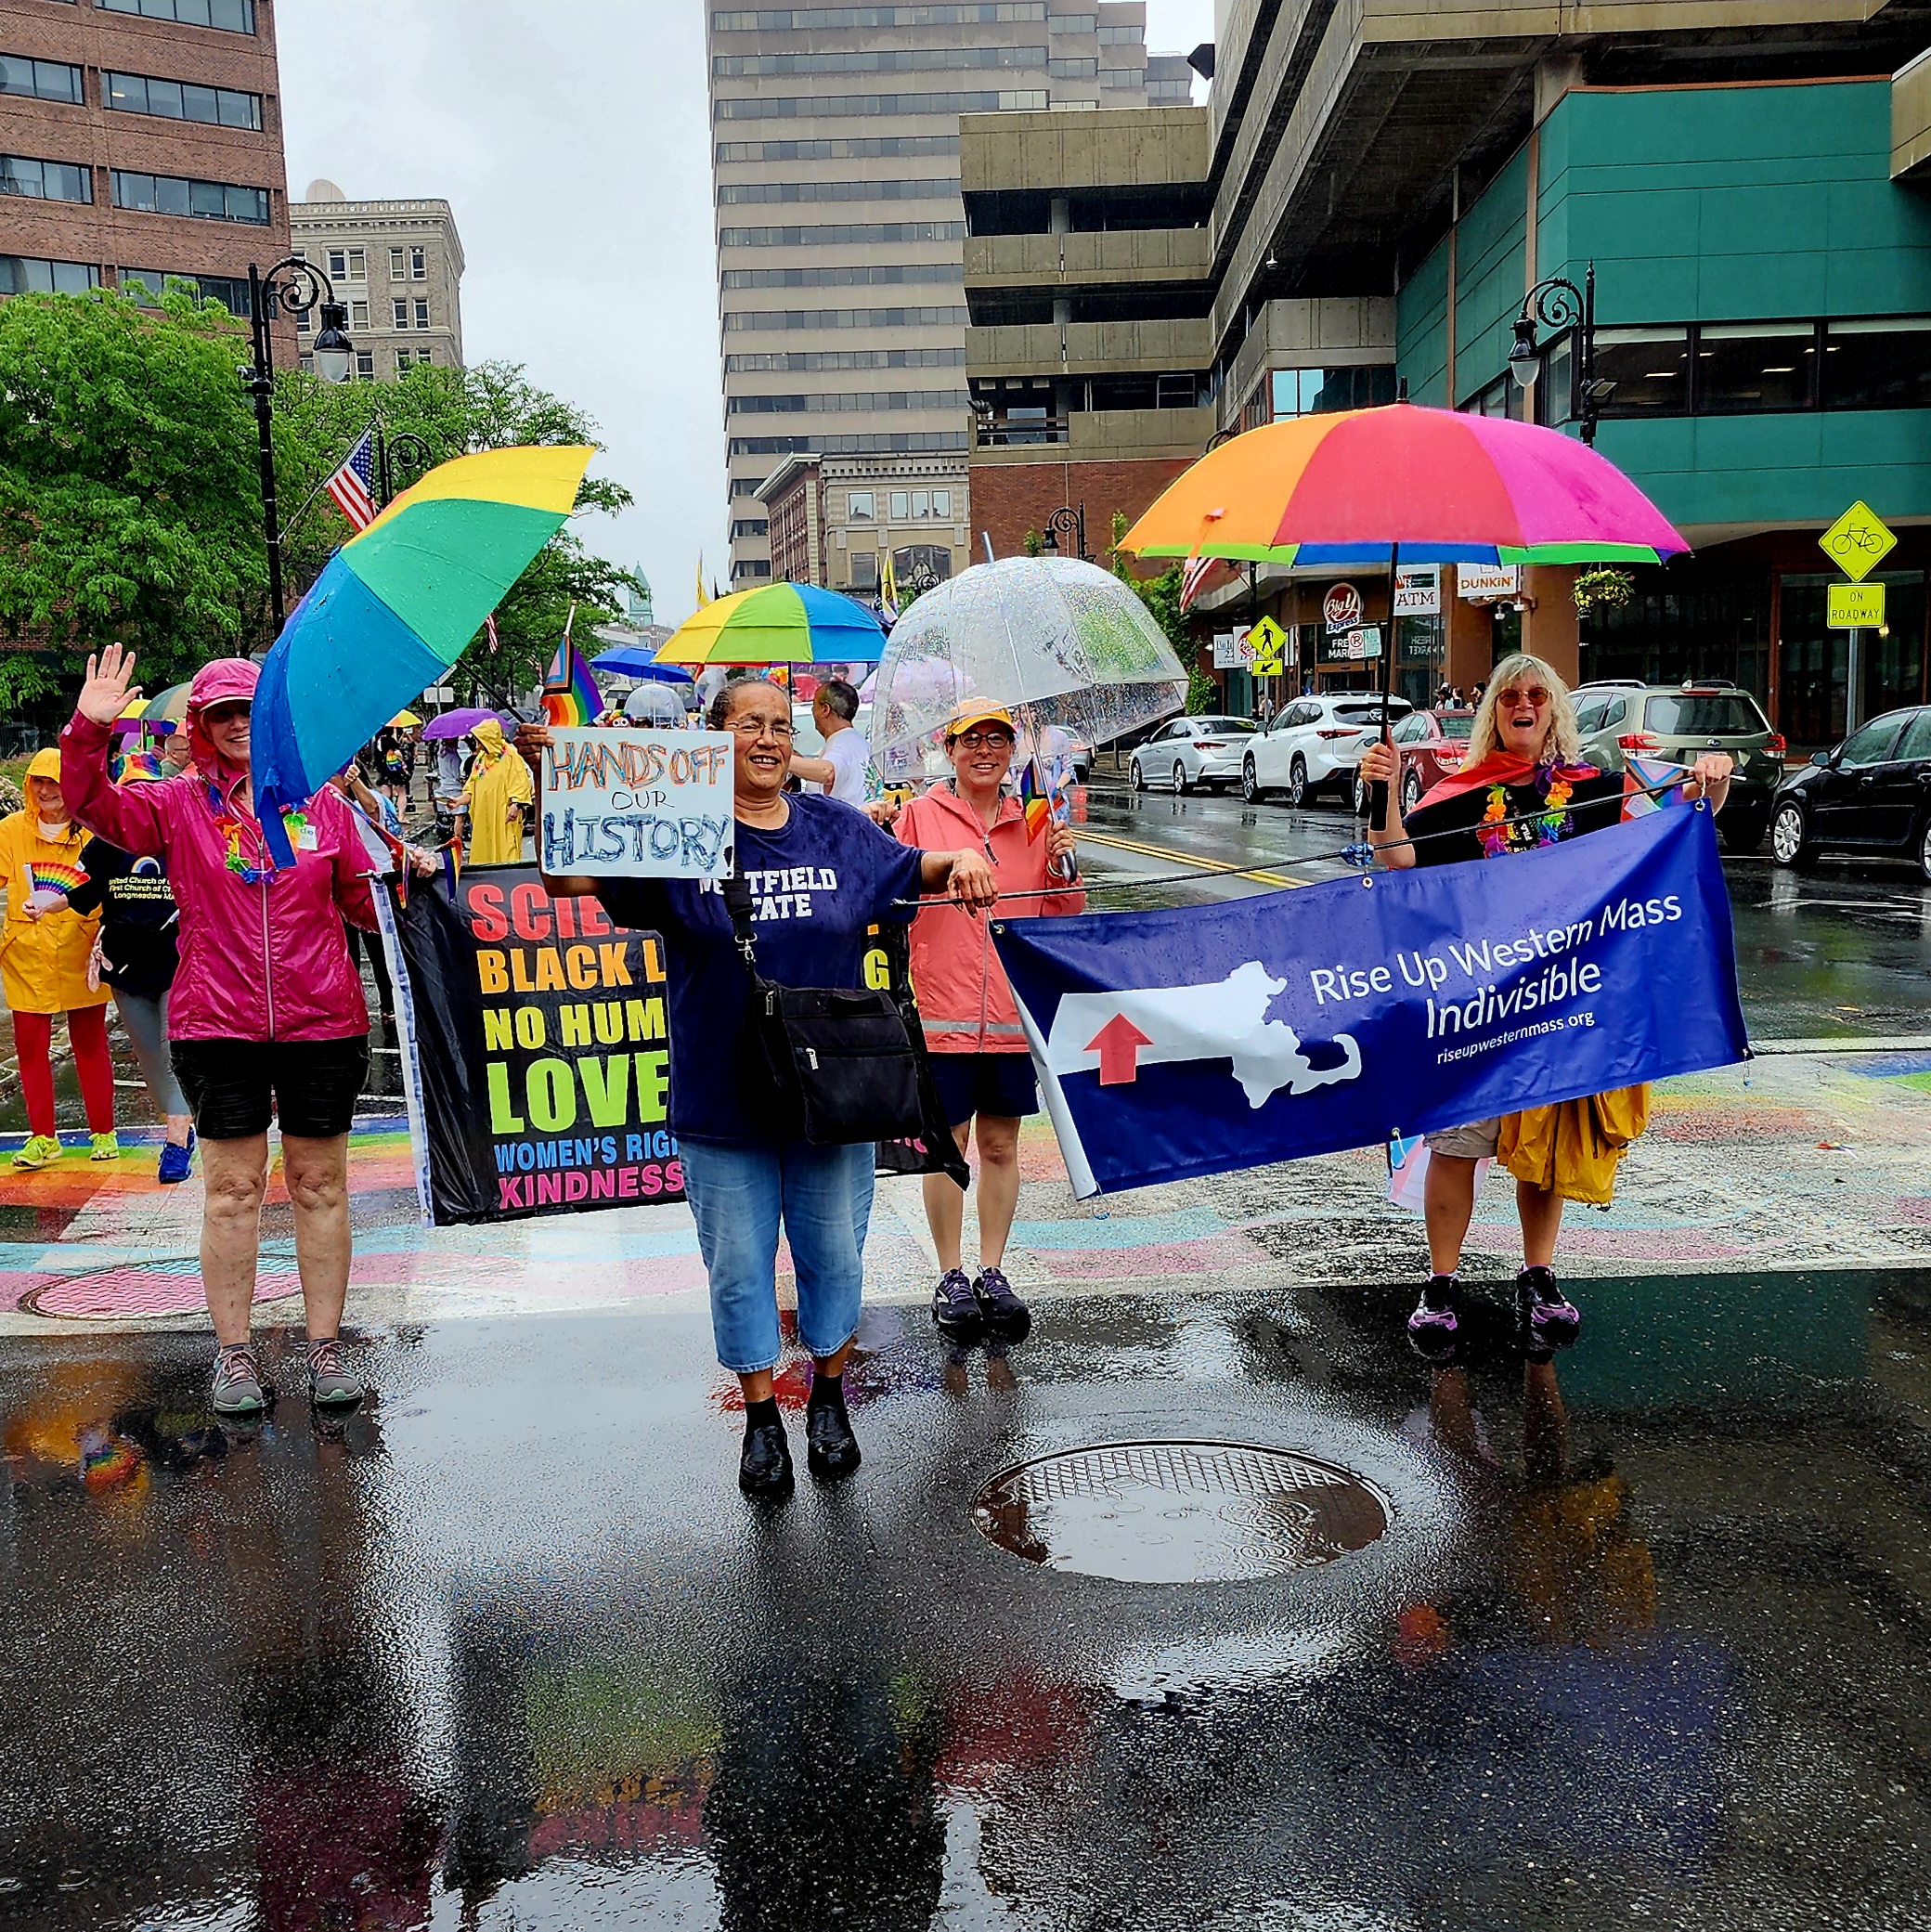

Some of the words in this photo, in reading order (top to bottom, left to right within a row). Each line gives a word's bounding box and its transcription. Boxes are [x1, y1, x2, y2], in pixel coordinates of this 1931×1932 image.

[1396, 592, 1435, 607] ATM
[1460, 576, 1514, 590] DUNKIN'
[1849, 591, 1863, 603] ON
[1326, 598, 1345, 616] Big
[1328, 616, 1358, 631] Express
[1832, 608, 1880, 620] ROADWAY
[1328, 649, 1350, 658] MAR
[543, 741, 667, 791] HANDS
[669, 745, 729, 785] OFF
[611, 790, 675, 810] OUR
[543, 807, 733, 877] HISTORY!
[129, 876, 157, 885] Church
[467, 883, 629, 941] SCIE
[476, 941, 634, 994] BLACK
[1310, 964, 1393, 1005] Rise
[1397, 950, 1447, 992] Up
[1448, 917, 1593, 979] Western
[1600, 894, 1682, 937] Mass
[1425, 956, 1603, 1039] Indivisible
[483, 1006, 546, 1051] NO
[559, 996, 667, 1047] HUM
[1436, 1010, 1595, 1066] riseupwesternmass.org
[486, 1049, 669, 1135] LOVE
[494, 1135, 617, 1173] WOMEN'S
[498, 1160, 685, 1210] KINDNESS
